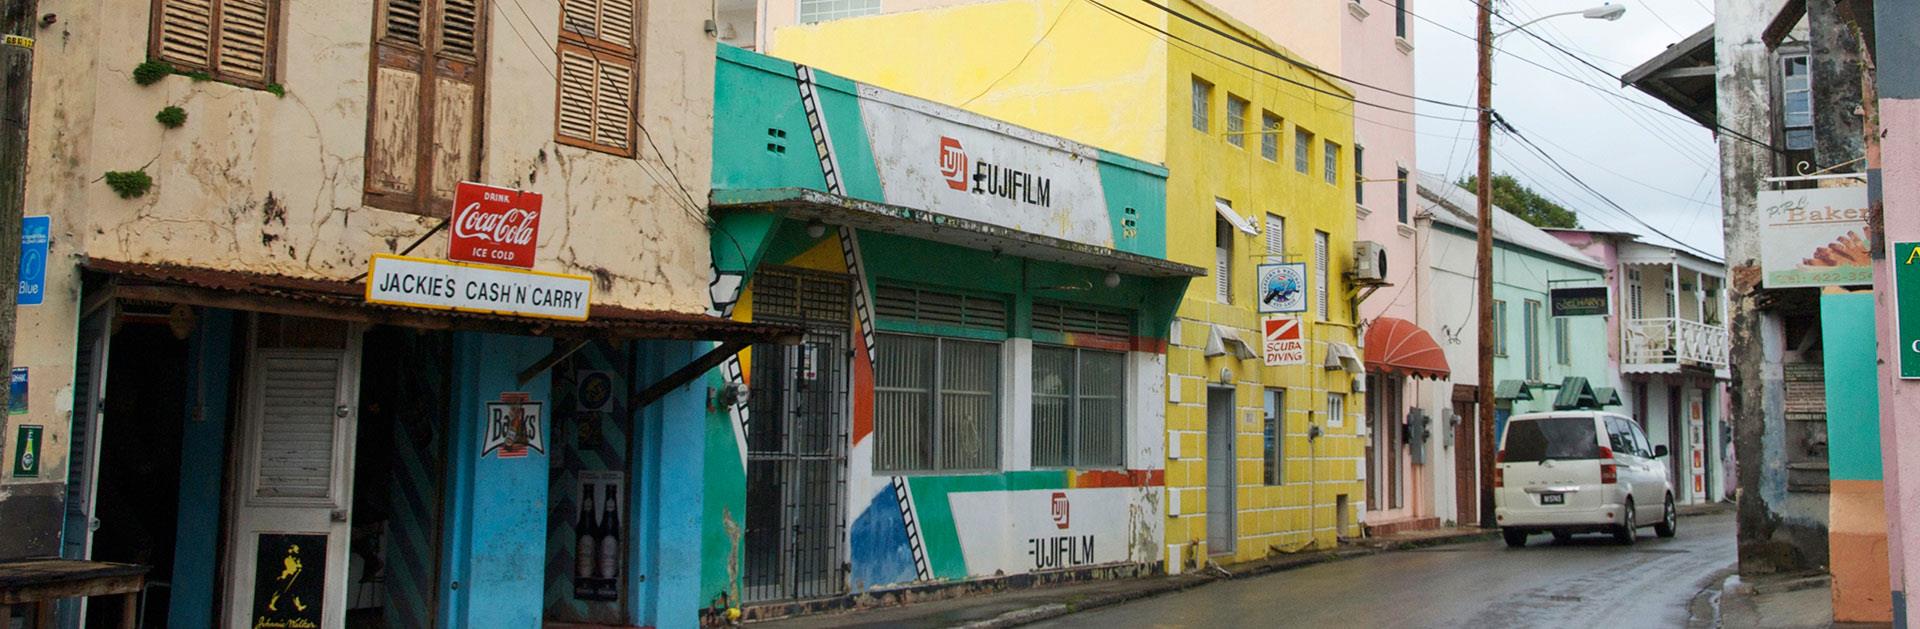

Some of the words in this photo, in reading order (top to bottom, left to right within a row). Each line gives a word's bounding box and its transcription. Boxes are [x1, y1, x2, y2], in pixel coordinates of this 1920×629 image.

[972, 161, 1050, 208] FUJIFILM
[484, 192, 510, 203] DRINK
[455, 202, 537, 245] Coca-Cola
[472, 247, 487, 257] ICE
[491, 250, 514, 260] COLD
[19, 280, 39, 294] Blue
[380, 273, 456, 298] JACKIE'S
[532, 287, 583, 309] CARRY
[1266, 341, 1302, 352] SCUBA
[1267, 352, 1302, 362] DIVING
[492, 408, 536, 441] Baks
